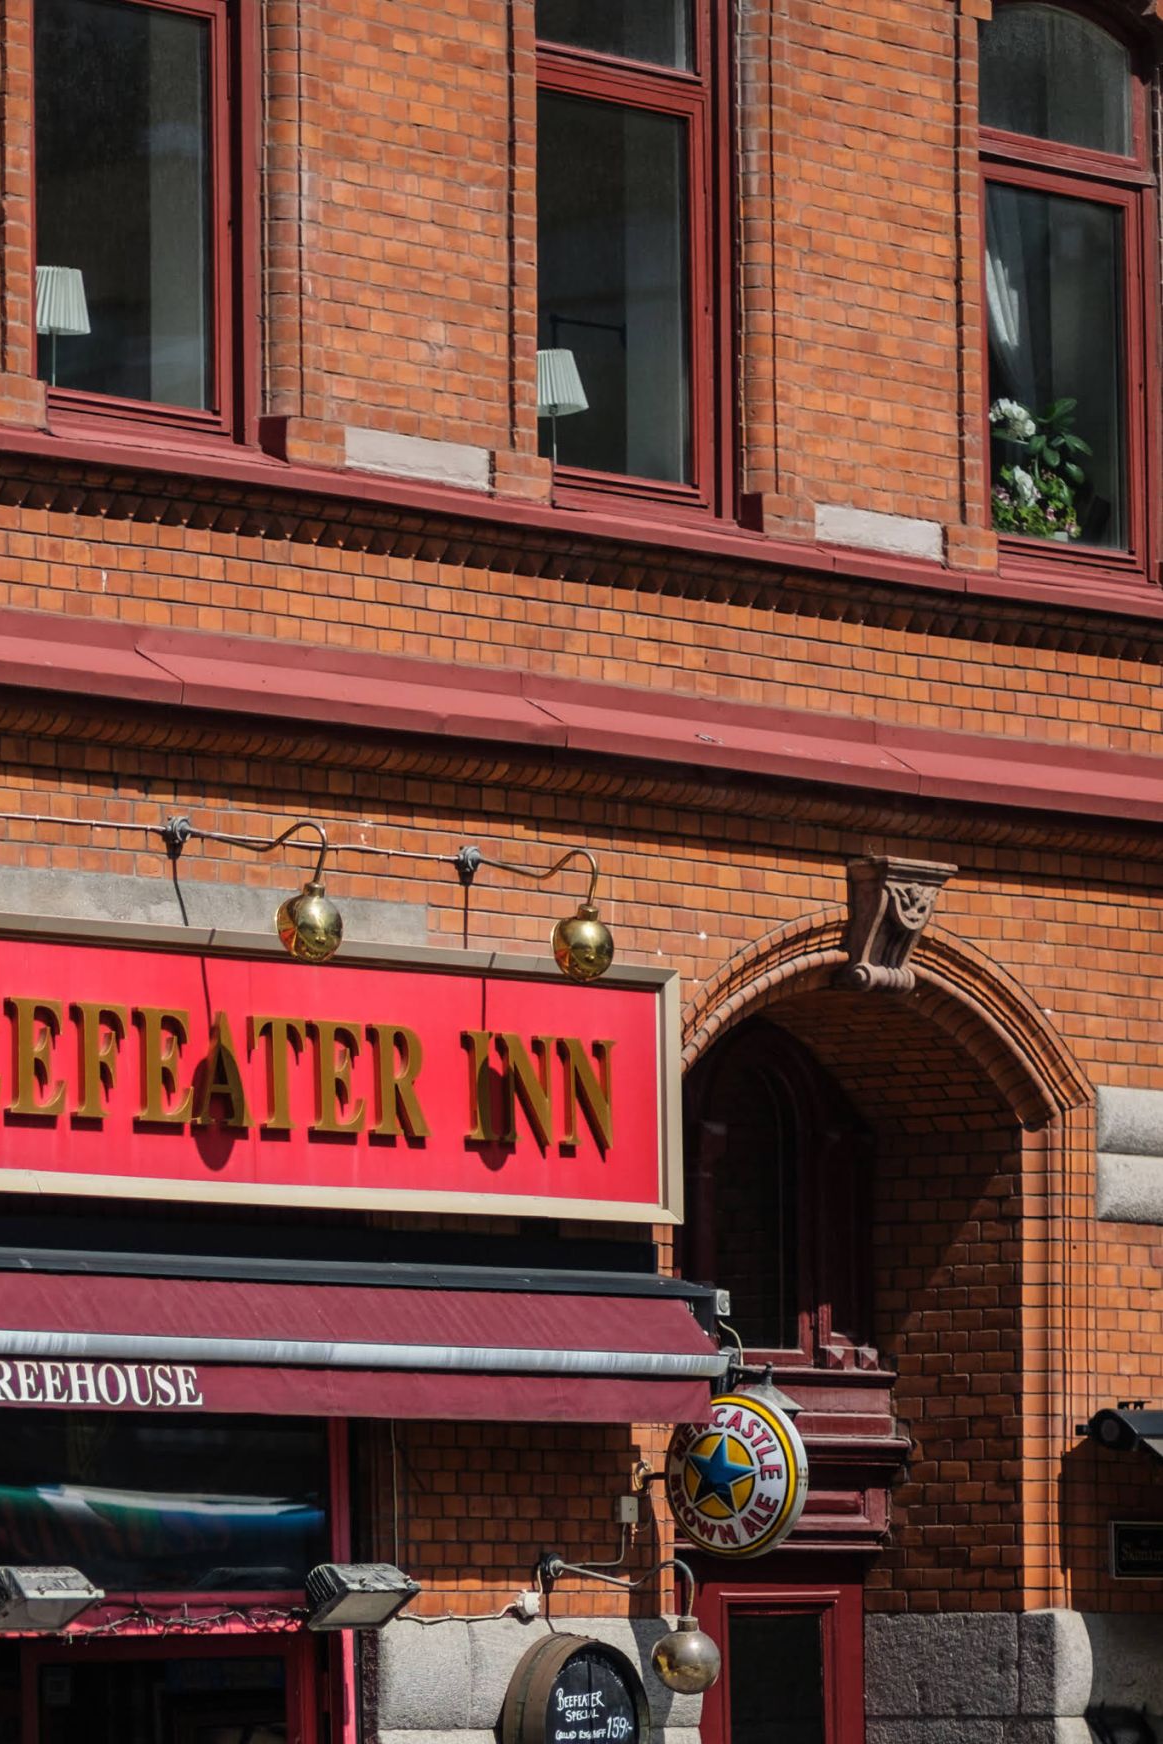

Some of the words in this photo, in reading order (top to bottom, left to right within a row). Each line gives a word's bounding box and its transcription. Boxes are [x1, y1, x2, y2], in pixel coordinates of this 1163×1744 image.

[459, 1030, 617, 1151] INN
[670, 1474, 740, 1545] BROWN
[741, 1492, 781, 1538] ALE
[556, 1688, 605, 1711] BEEFEATER
